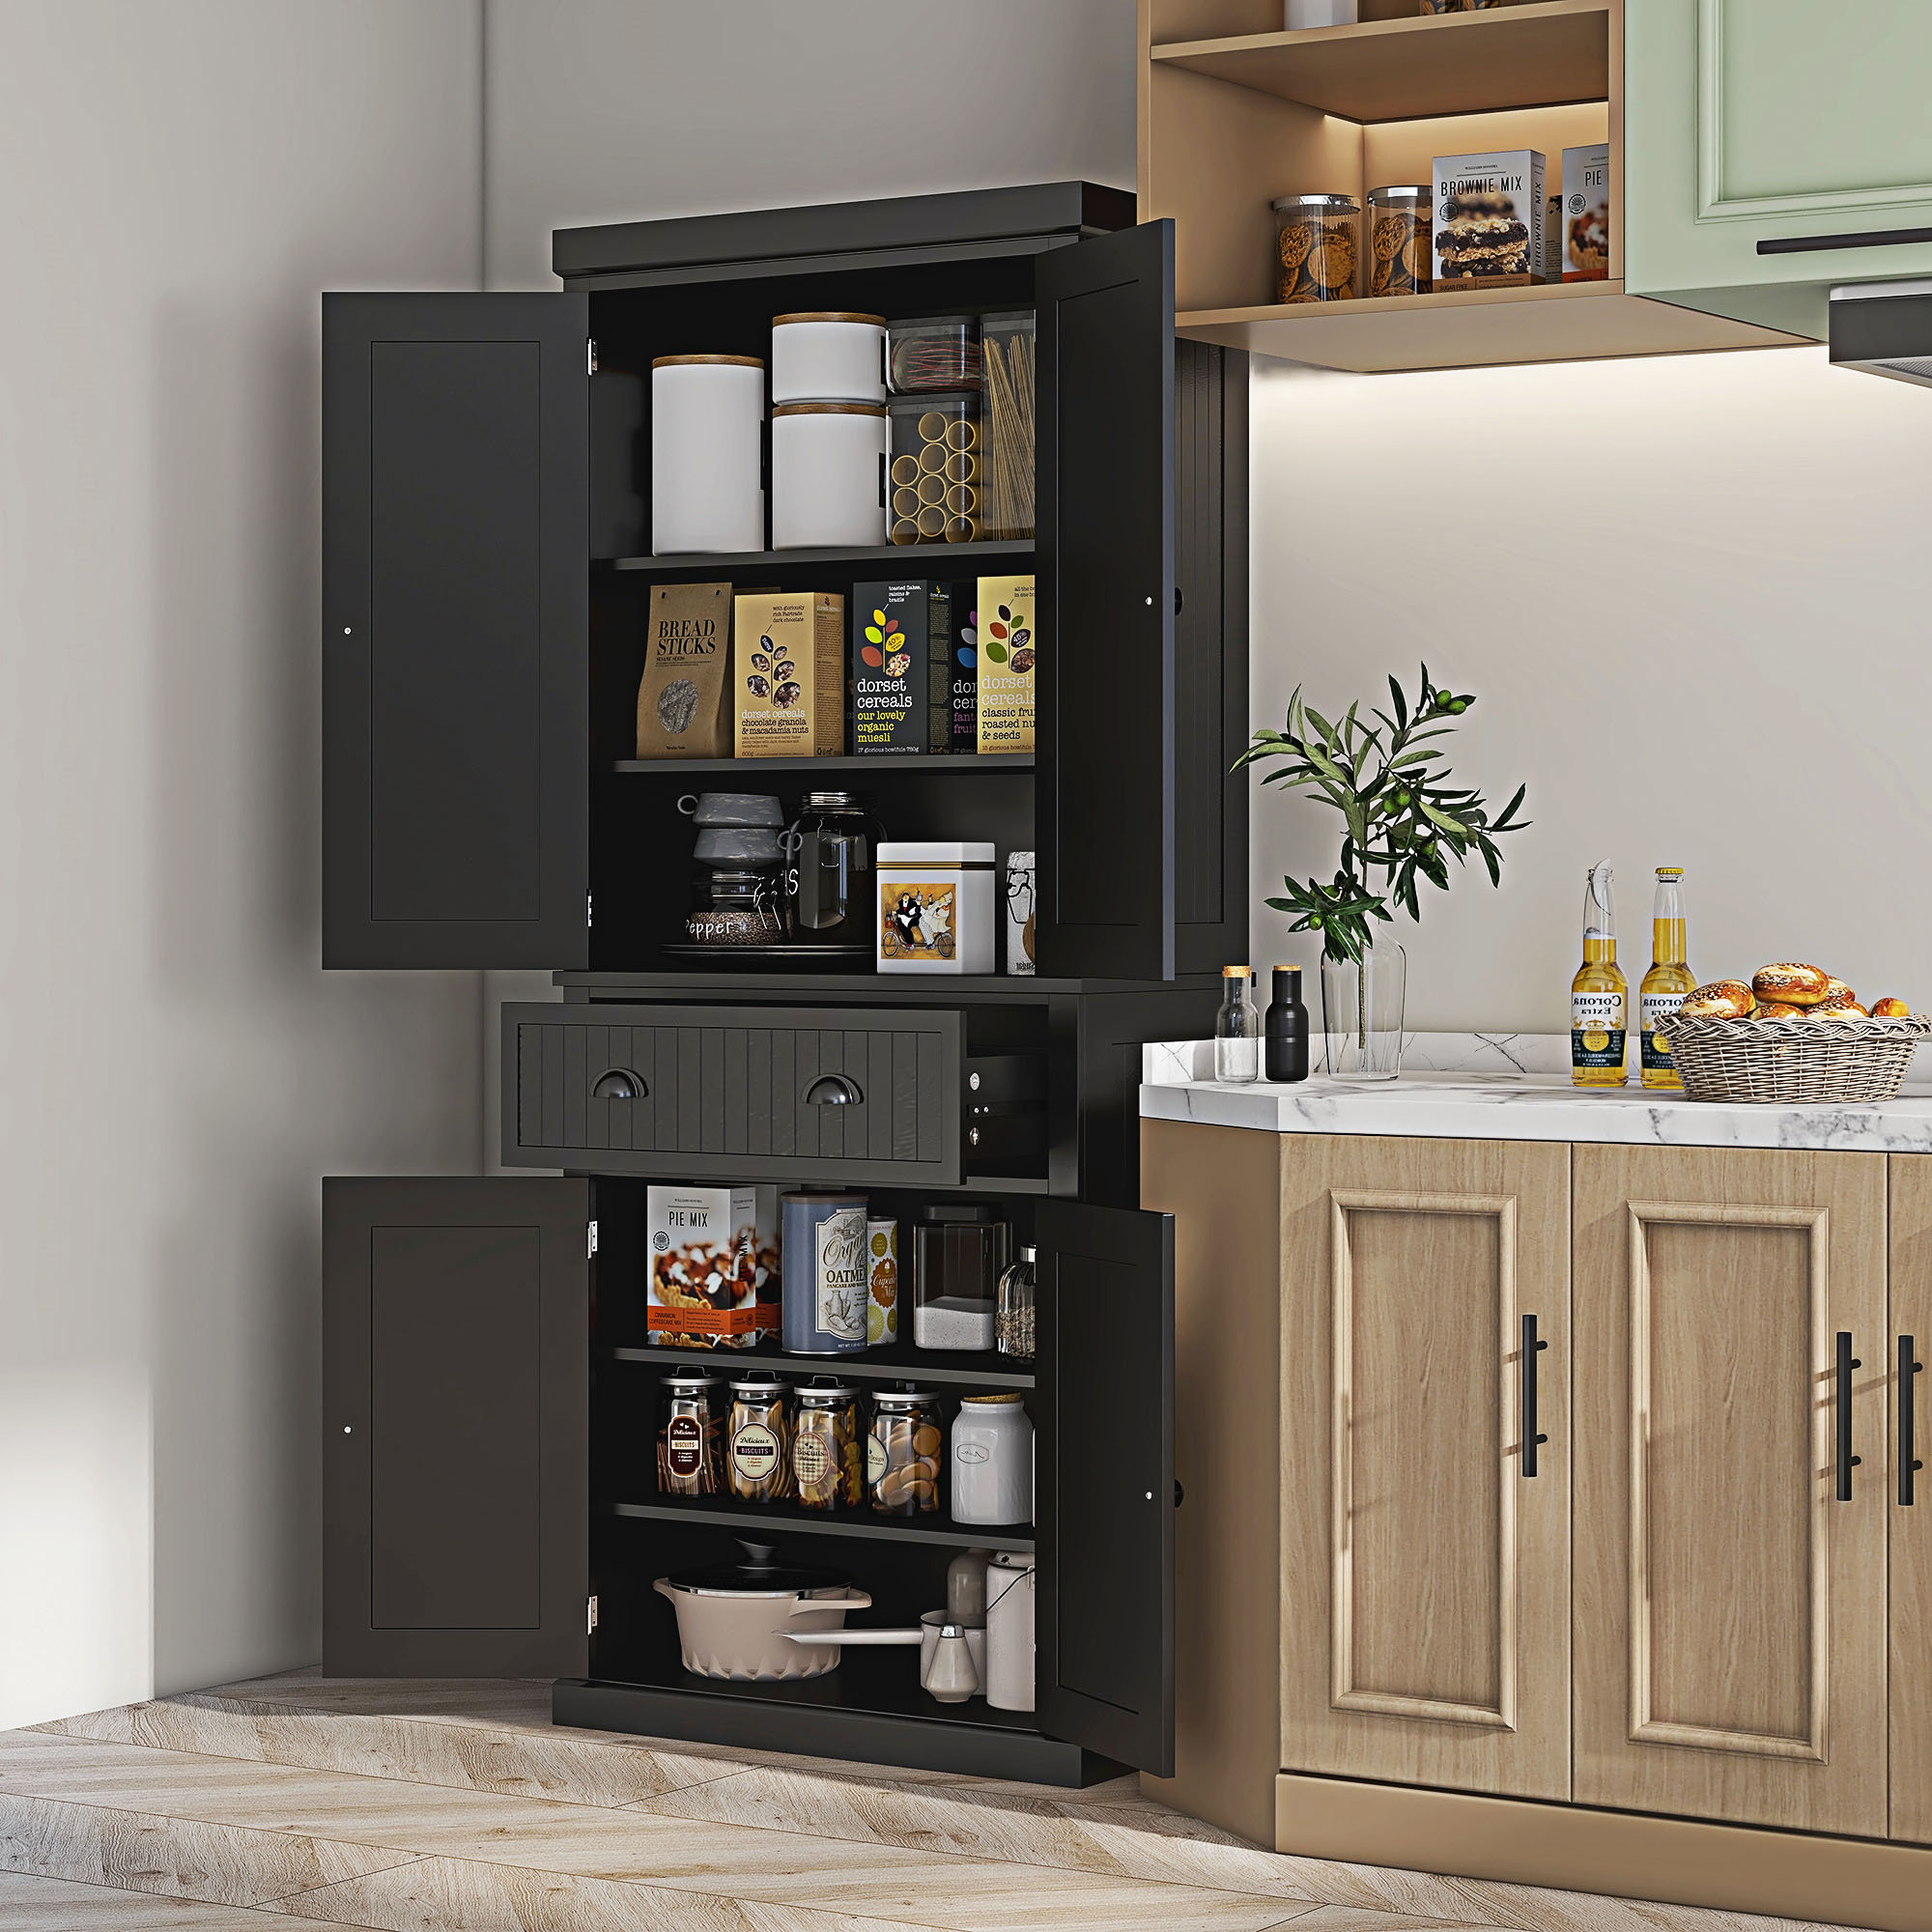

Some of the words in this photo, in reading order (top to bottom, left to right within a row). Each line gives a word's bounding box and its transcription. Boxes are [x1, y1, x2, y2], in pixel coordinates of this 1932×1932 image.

[1585, 170, 1602, 186] PIE
[1440, 178, 1494, 196] BROWNIE
[1500, 176, 1522, 192] MIX
[658, 619, 716, 639] BREAD
[657, 637, 716, 656] STICKS
[857, 677, 907, 693] dorset
[952, 679, 978, 694] dor
[981, 674, 1033, 690] dorset
[857, 694, 913, 709] cereals
[980, 690, 1036, 706] cereals
[741, 709, 771, 719] dorset
[772, 708, 806, 719] cereals
[857, 712, 875, 721] our
[876, 710, 906, 722] lovely
[953, 712, 977, 722] fant
[981, 708, 1016, 718] classic
[1018, 707, 1036, 717] fru
[778, 718, 807, 727] granola
[857, 722, 895, 733] organic
[953, 724, 977, 734] fruit
[981, 719, 1020, 729] roasted
[1022, 720, 1036, 728] nu
[857, 732, 891, 743] muesli
[981, 730, 991, 740] &
[992, 729, 1021, 740] seeds
[668, 1211, 684, 1227] PIE
[690, 1212, 708, 1228] MIX
[738, 1236, 748, 1257] MIX
[826, 1268, 867, 1283] OATME
